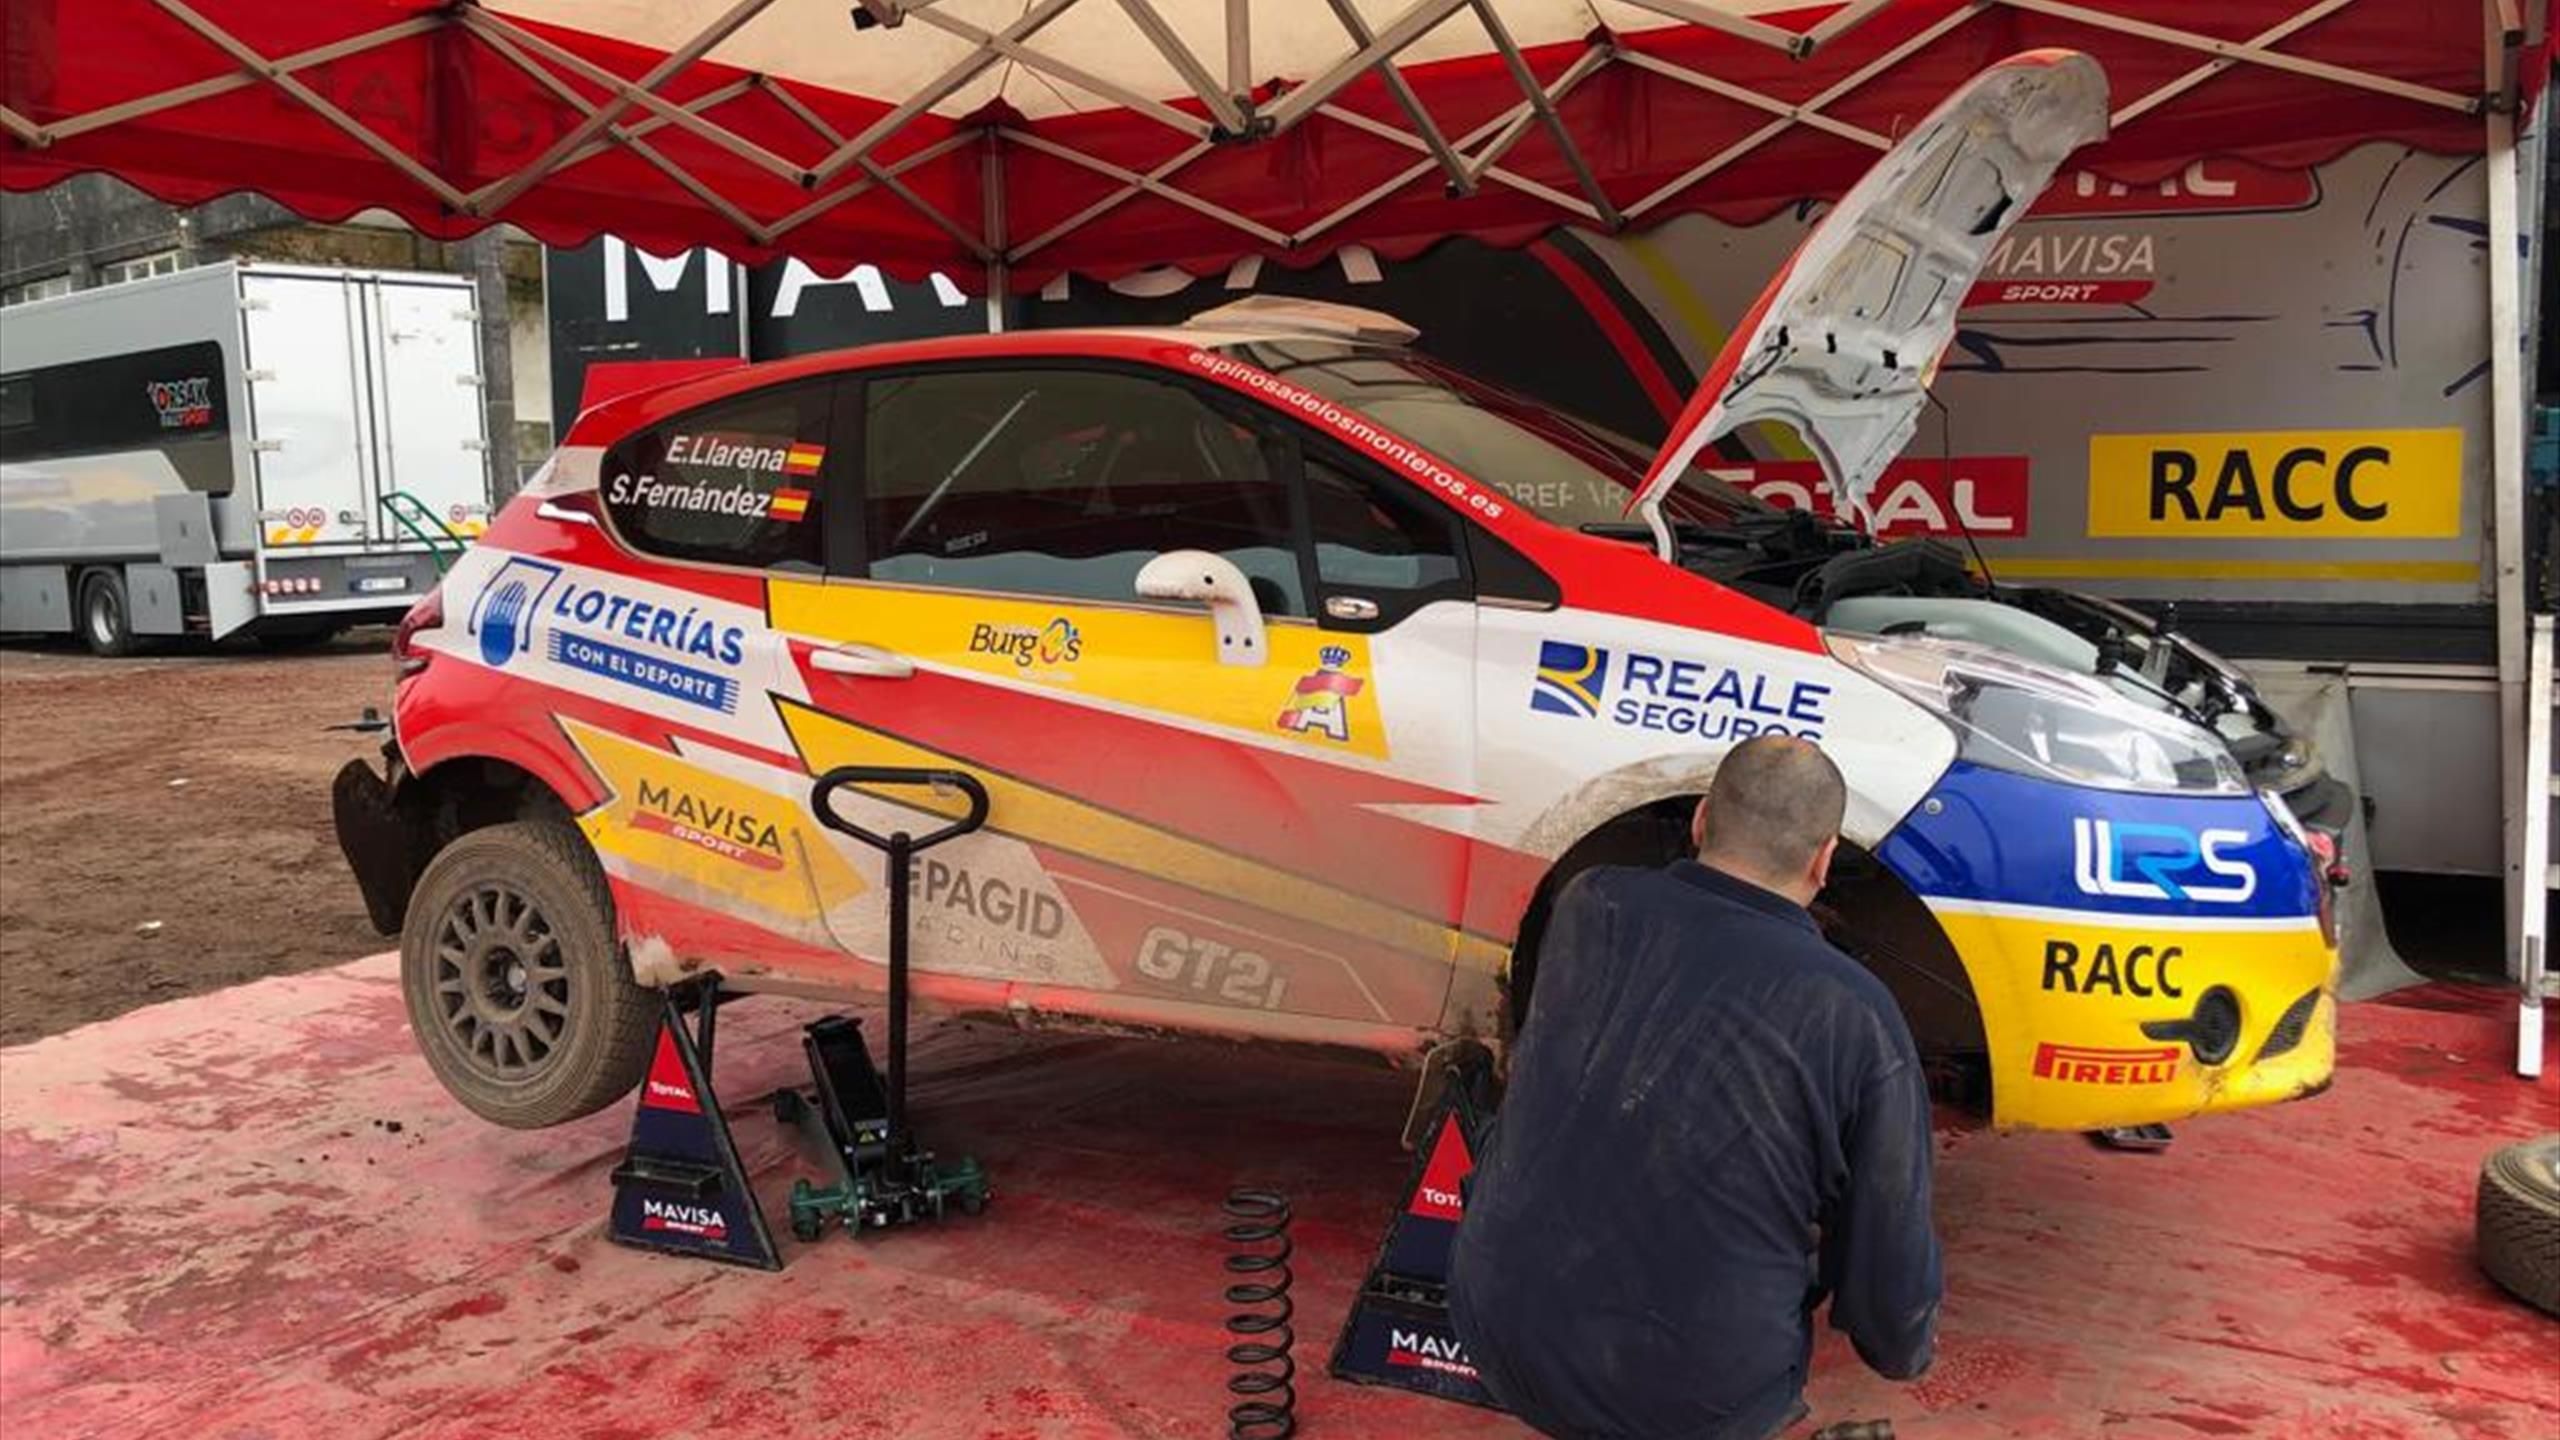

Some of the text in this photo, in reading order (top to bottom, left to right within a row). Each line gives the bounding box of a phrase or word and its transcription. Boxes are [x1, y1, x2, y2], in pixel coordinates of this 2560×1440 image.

[2002, 284, 2099, 301] SPORT
[665, 435, 786, 471] E.Llarena
[1187, 350, 1505, 519] espinosadelosmonteros.es
[609, 474, 772, 517] S.Fernández
[2149, 447, 2391, 521] RACC
[554, 584, 744, 666] LOTERÍAS
[568, 643, 718, 700] CON EL DEPORTE
[1623, 653, 1831, 724] REALE
[638, 779, 782, 854] MAVISA
[671, 824, 748, 858] SPORT
[2042, 940, 2183, 998] RACC
[2032, 1042, 2181, 1084] PIRELLI
[643, 1199, 725, 1228] MAVISA
